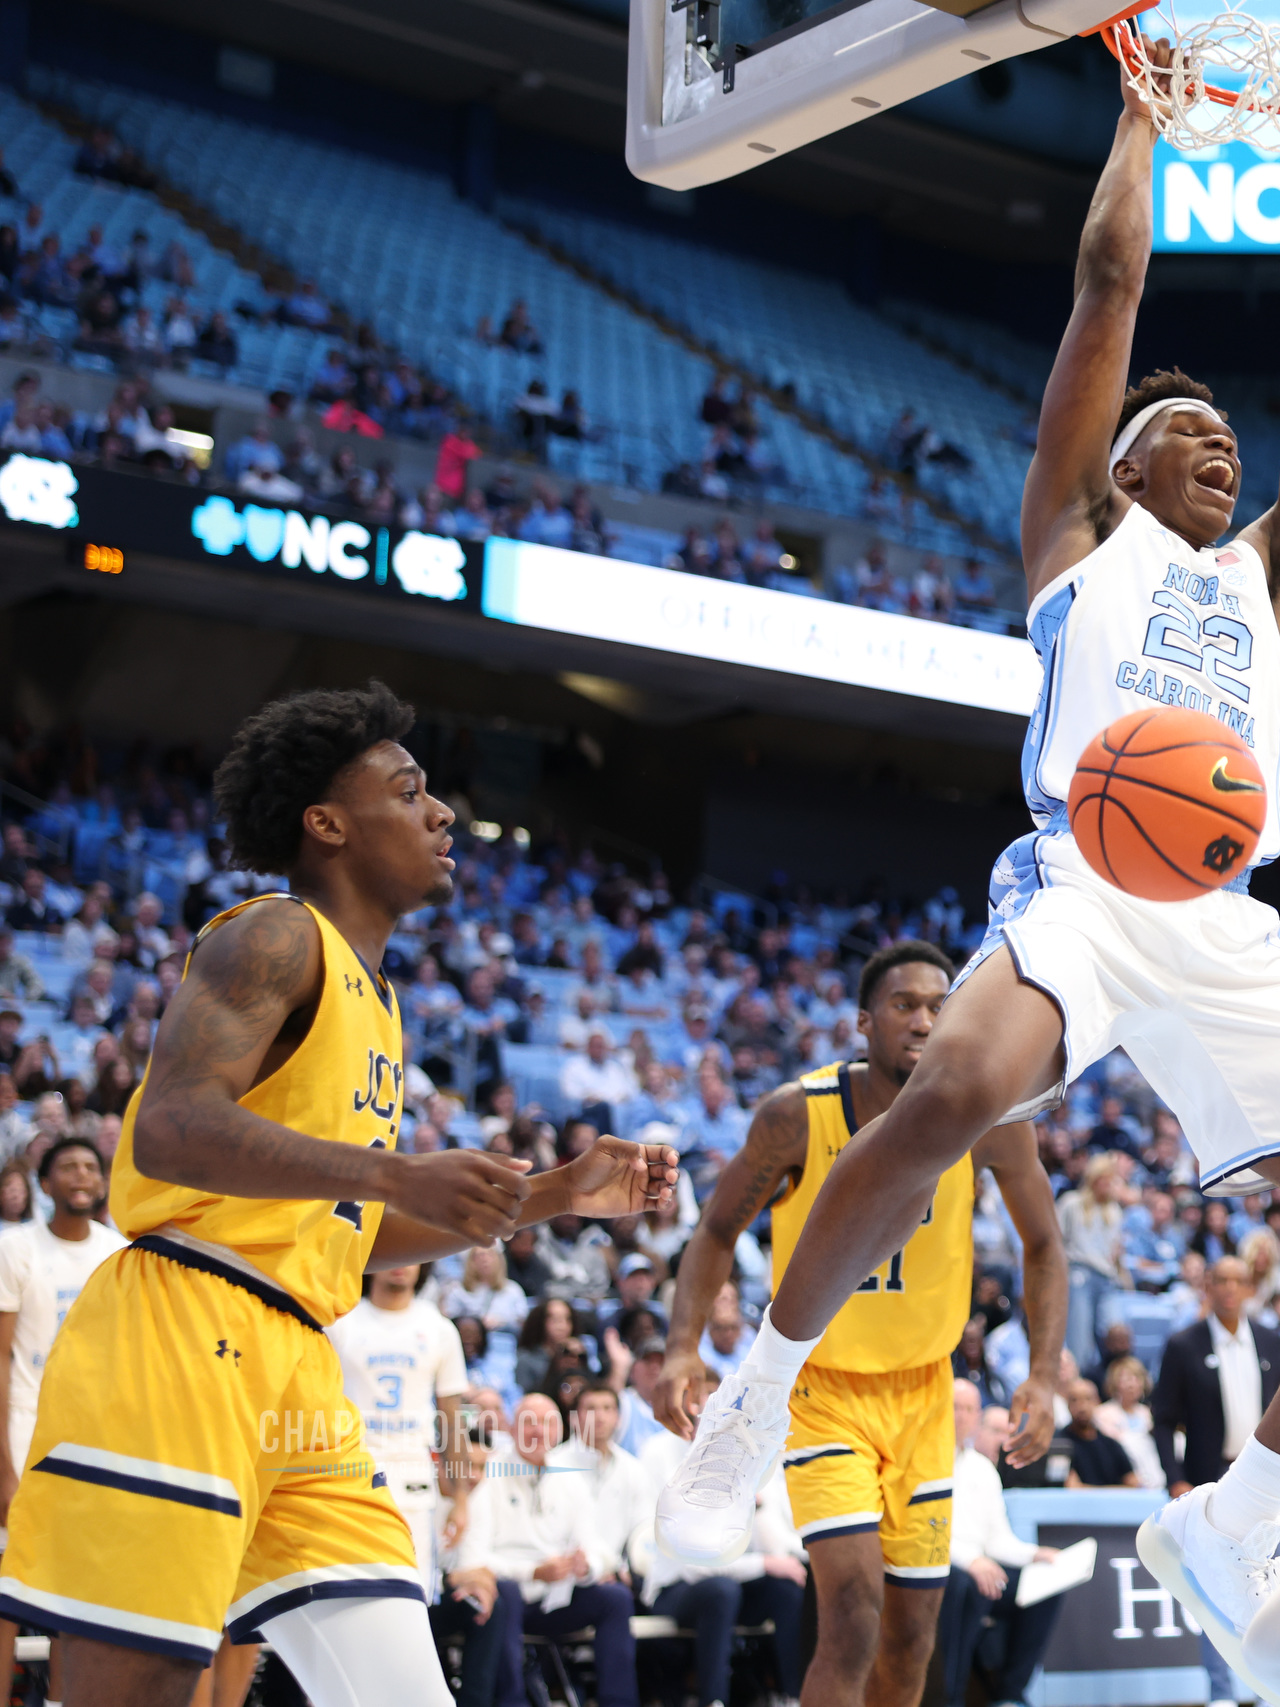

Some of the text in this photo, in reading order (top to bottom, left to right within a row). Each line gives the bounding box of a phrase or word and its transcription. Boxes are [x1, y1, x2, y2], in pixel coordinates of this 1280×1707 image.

[1162, 562, 1244, 619] NORH
[1142, 590, 1253, 704] 22
[375, 1375, 402, 1409] 3
